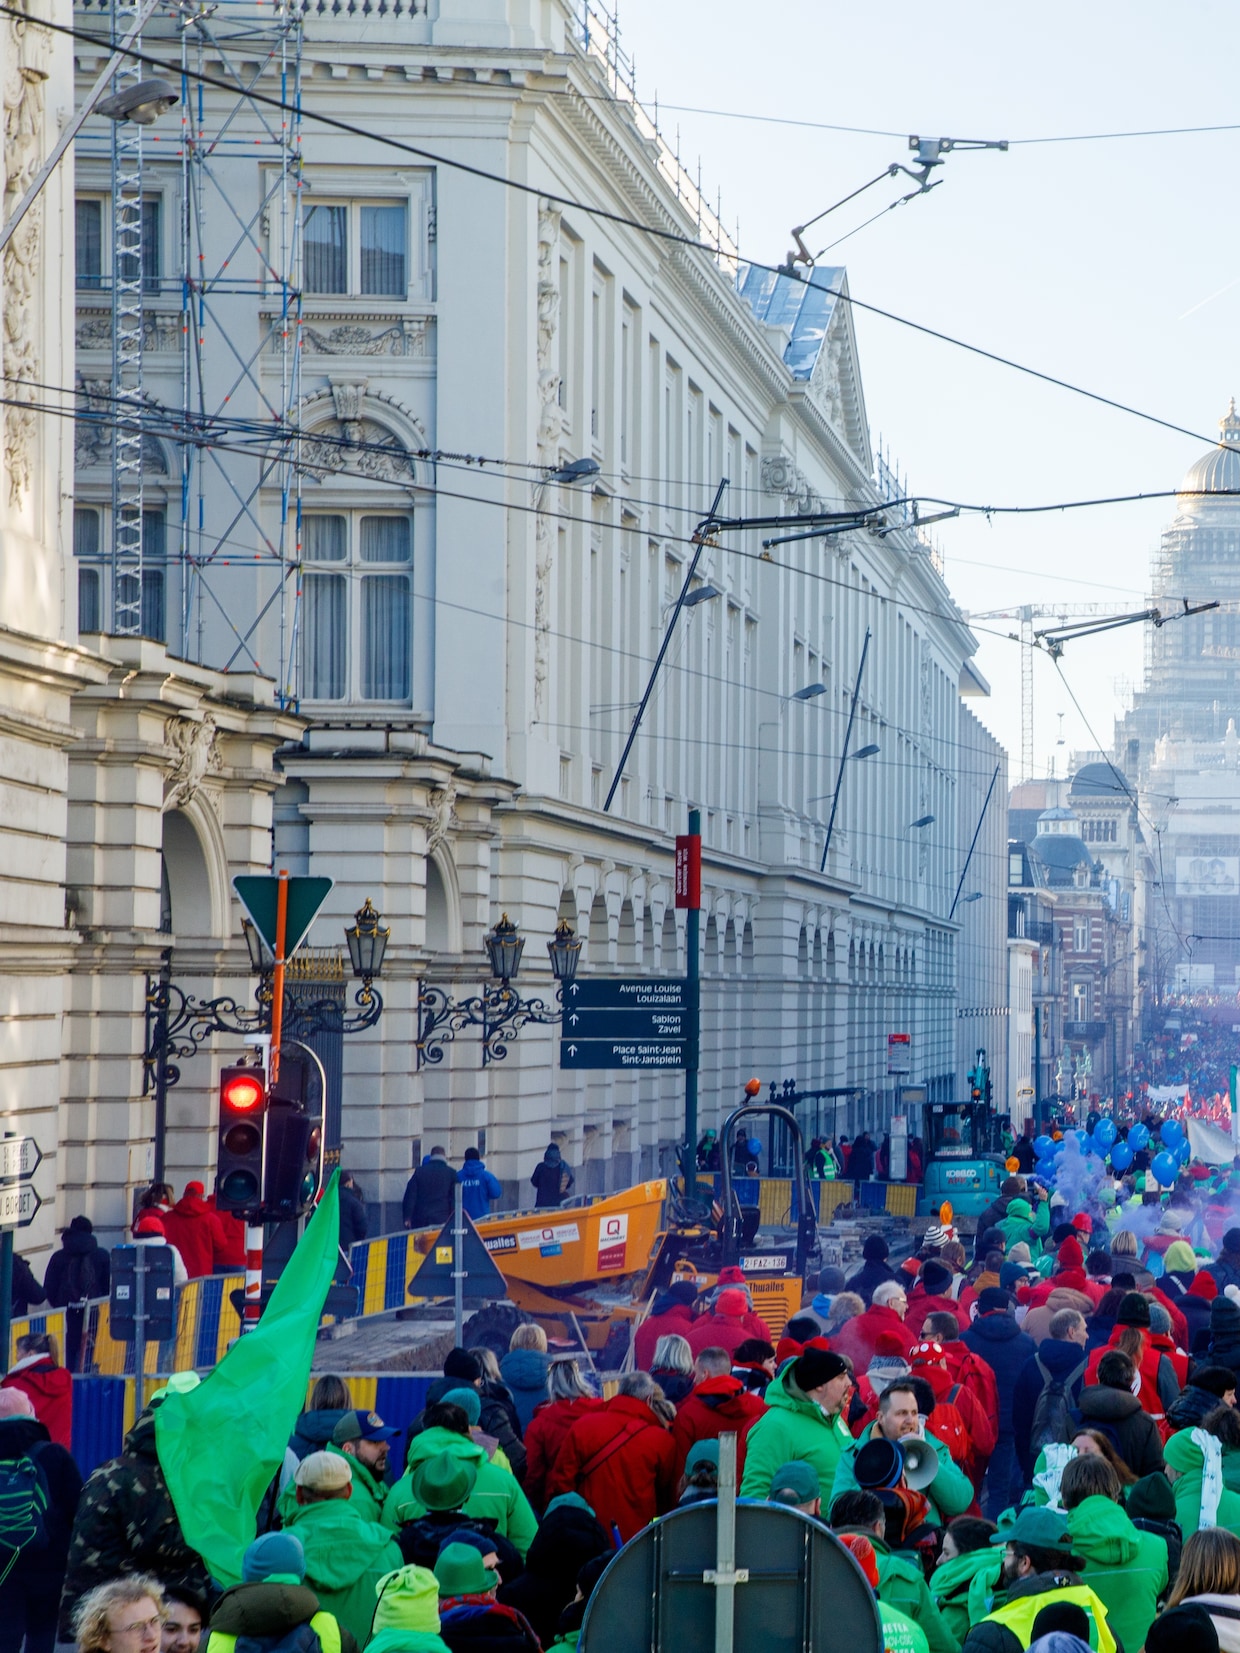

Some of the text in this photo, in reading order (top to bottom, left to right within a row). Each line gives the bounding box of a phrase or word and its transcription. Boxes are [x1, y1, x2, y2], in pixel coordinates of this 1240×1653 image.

[619, 984, 682, 993] Avenue Louise
[636, 994, 682, 1003] Louizalaan
[651, 1015, 681, 1023] Sablon
[658, 1025, 681, 1034] Zavel
[612, 1046, 682, 1055] Place Saint-Jean
[622, 1056, 682, 1065] Sint-Jansplein
[484, 1236, 516, 1250] waites
[749, 1282, 785, 1293] Thwaites
